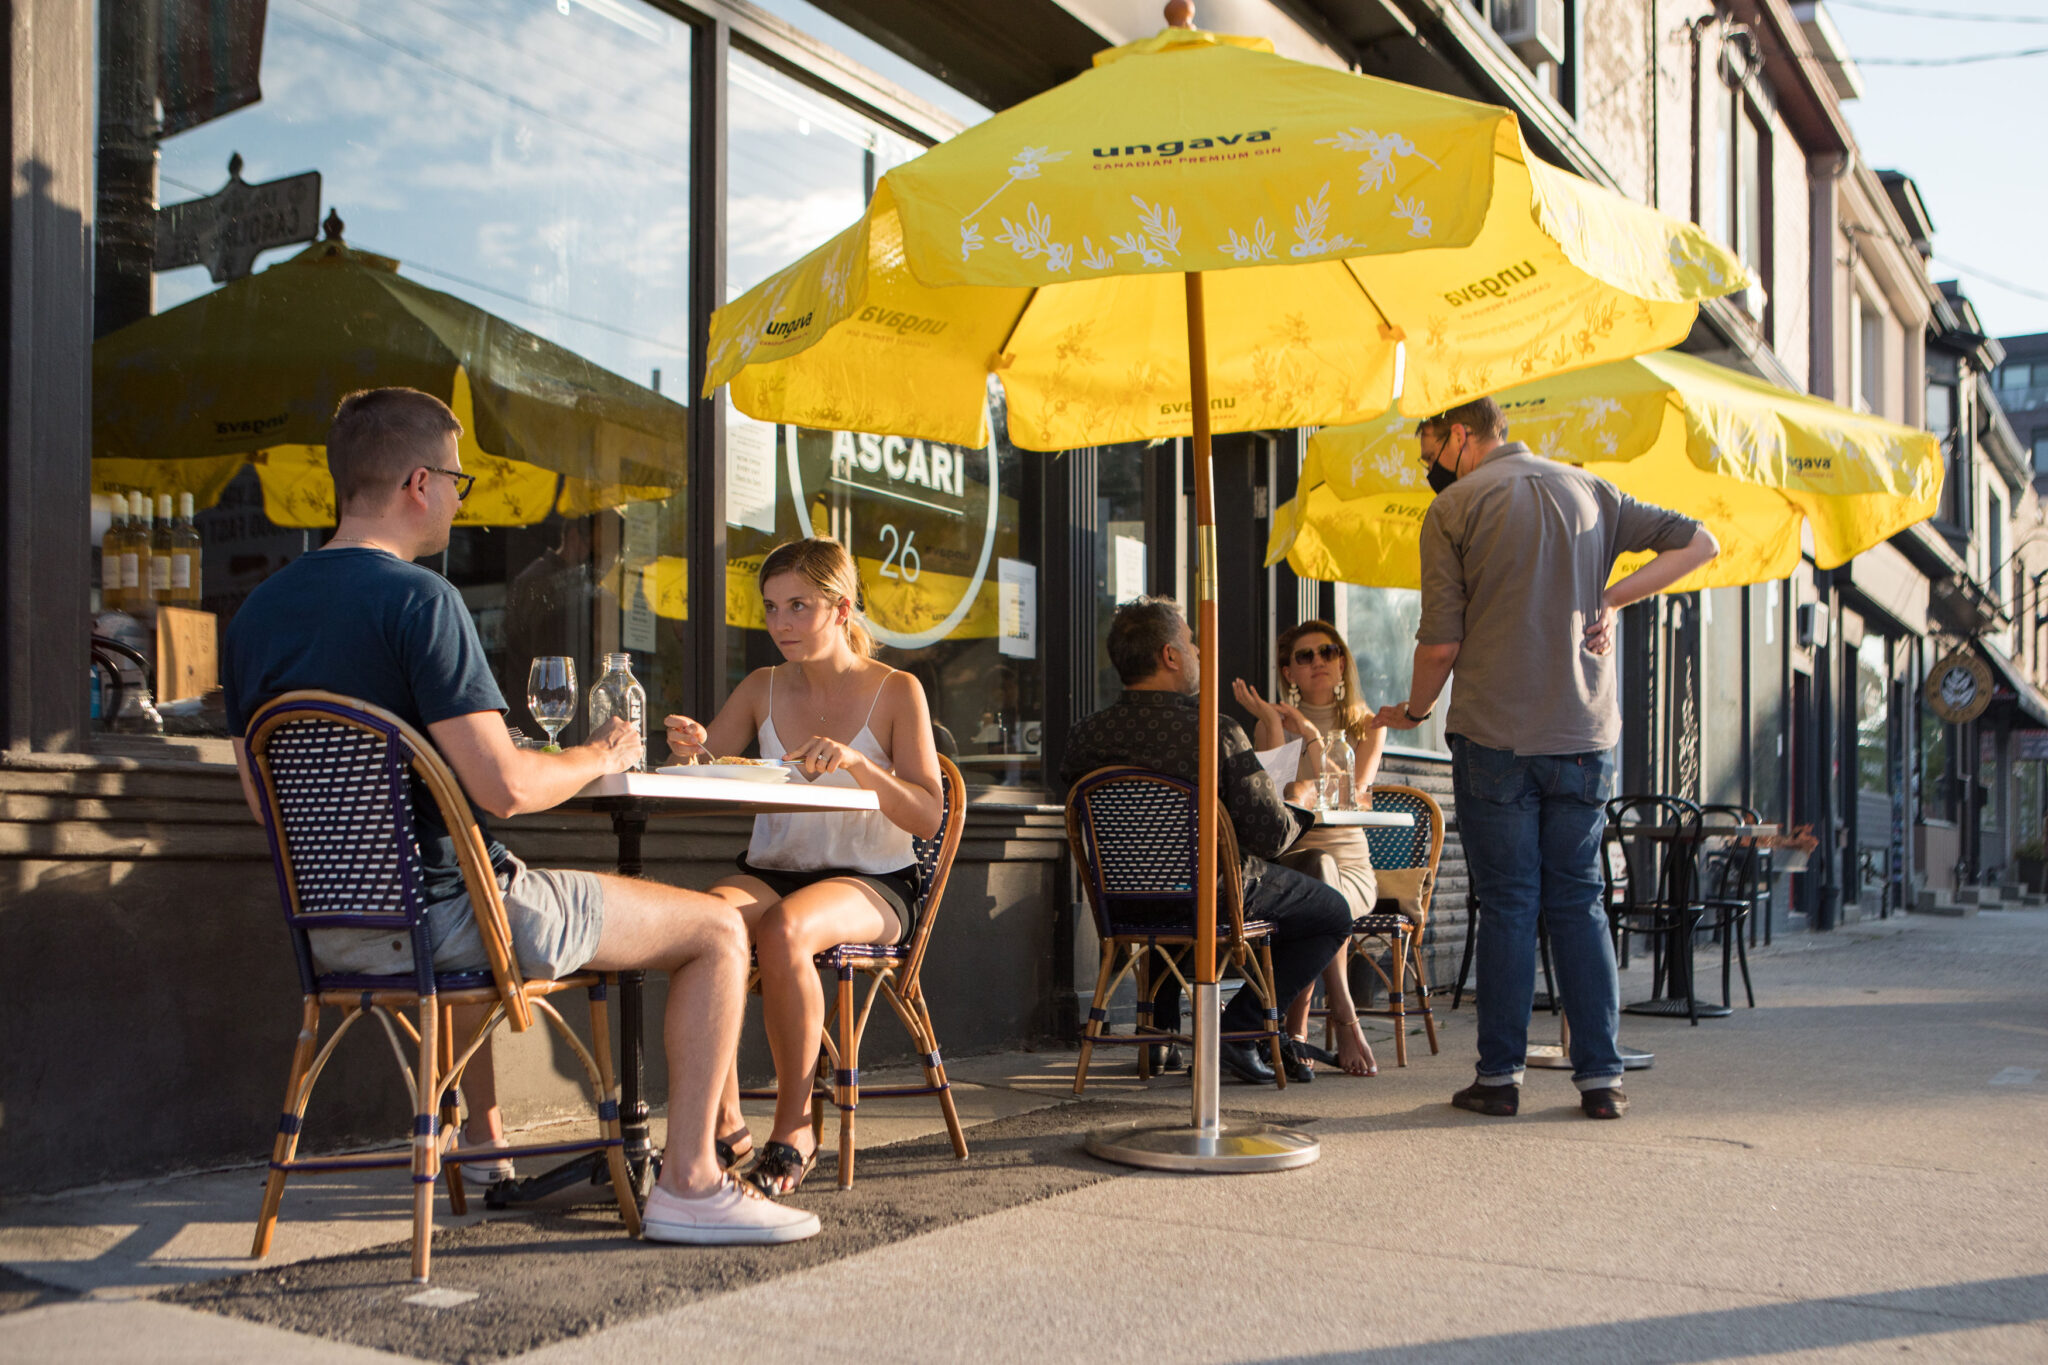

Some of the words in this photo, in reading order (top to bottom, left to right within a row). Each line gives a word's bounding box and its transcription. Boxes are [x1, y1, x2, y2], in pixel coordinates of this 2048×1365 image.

[1093, 130, 1272, 157] ungava
[1093, 159, 1173, 170] CANADIAN
[1179, 152, 1249, 164] PREMIUM
[1255, 147, 1282, 156] GIN
[766, 312, 813, 339] ungava
[830, 430, 964, 498] ASCARI
[880, 524, 920, 582] 26
